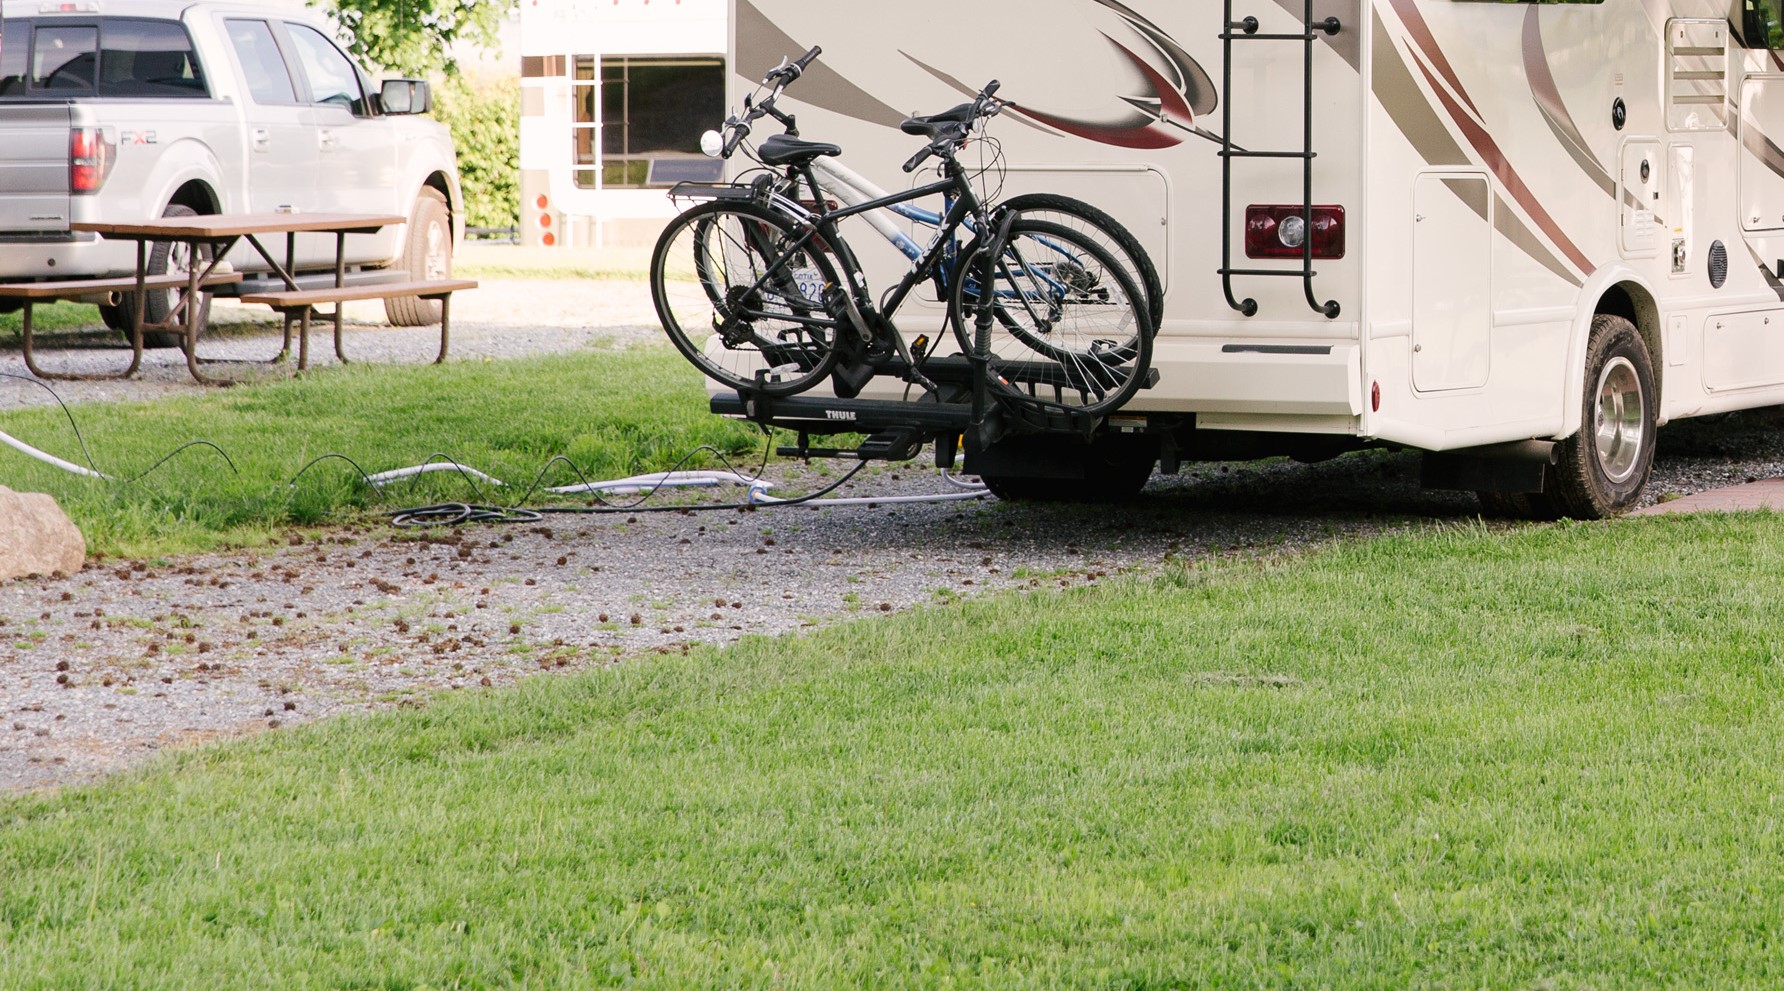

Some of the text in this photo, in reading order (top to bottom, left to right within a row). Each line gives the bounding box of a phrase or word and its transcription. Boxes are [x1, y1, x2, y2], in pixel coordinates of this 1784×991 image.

[121, 130, 157, 145] FX2
[910, 214, 952, 275] TREK
[825, 409, 857, 421] THULE
